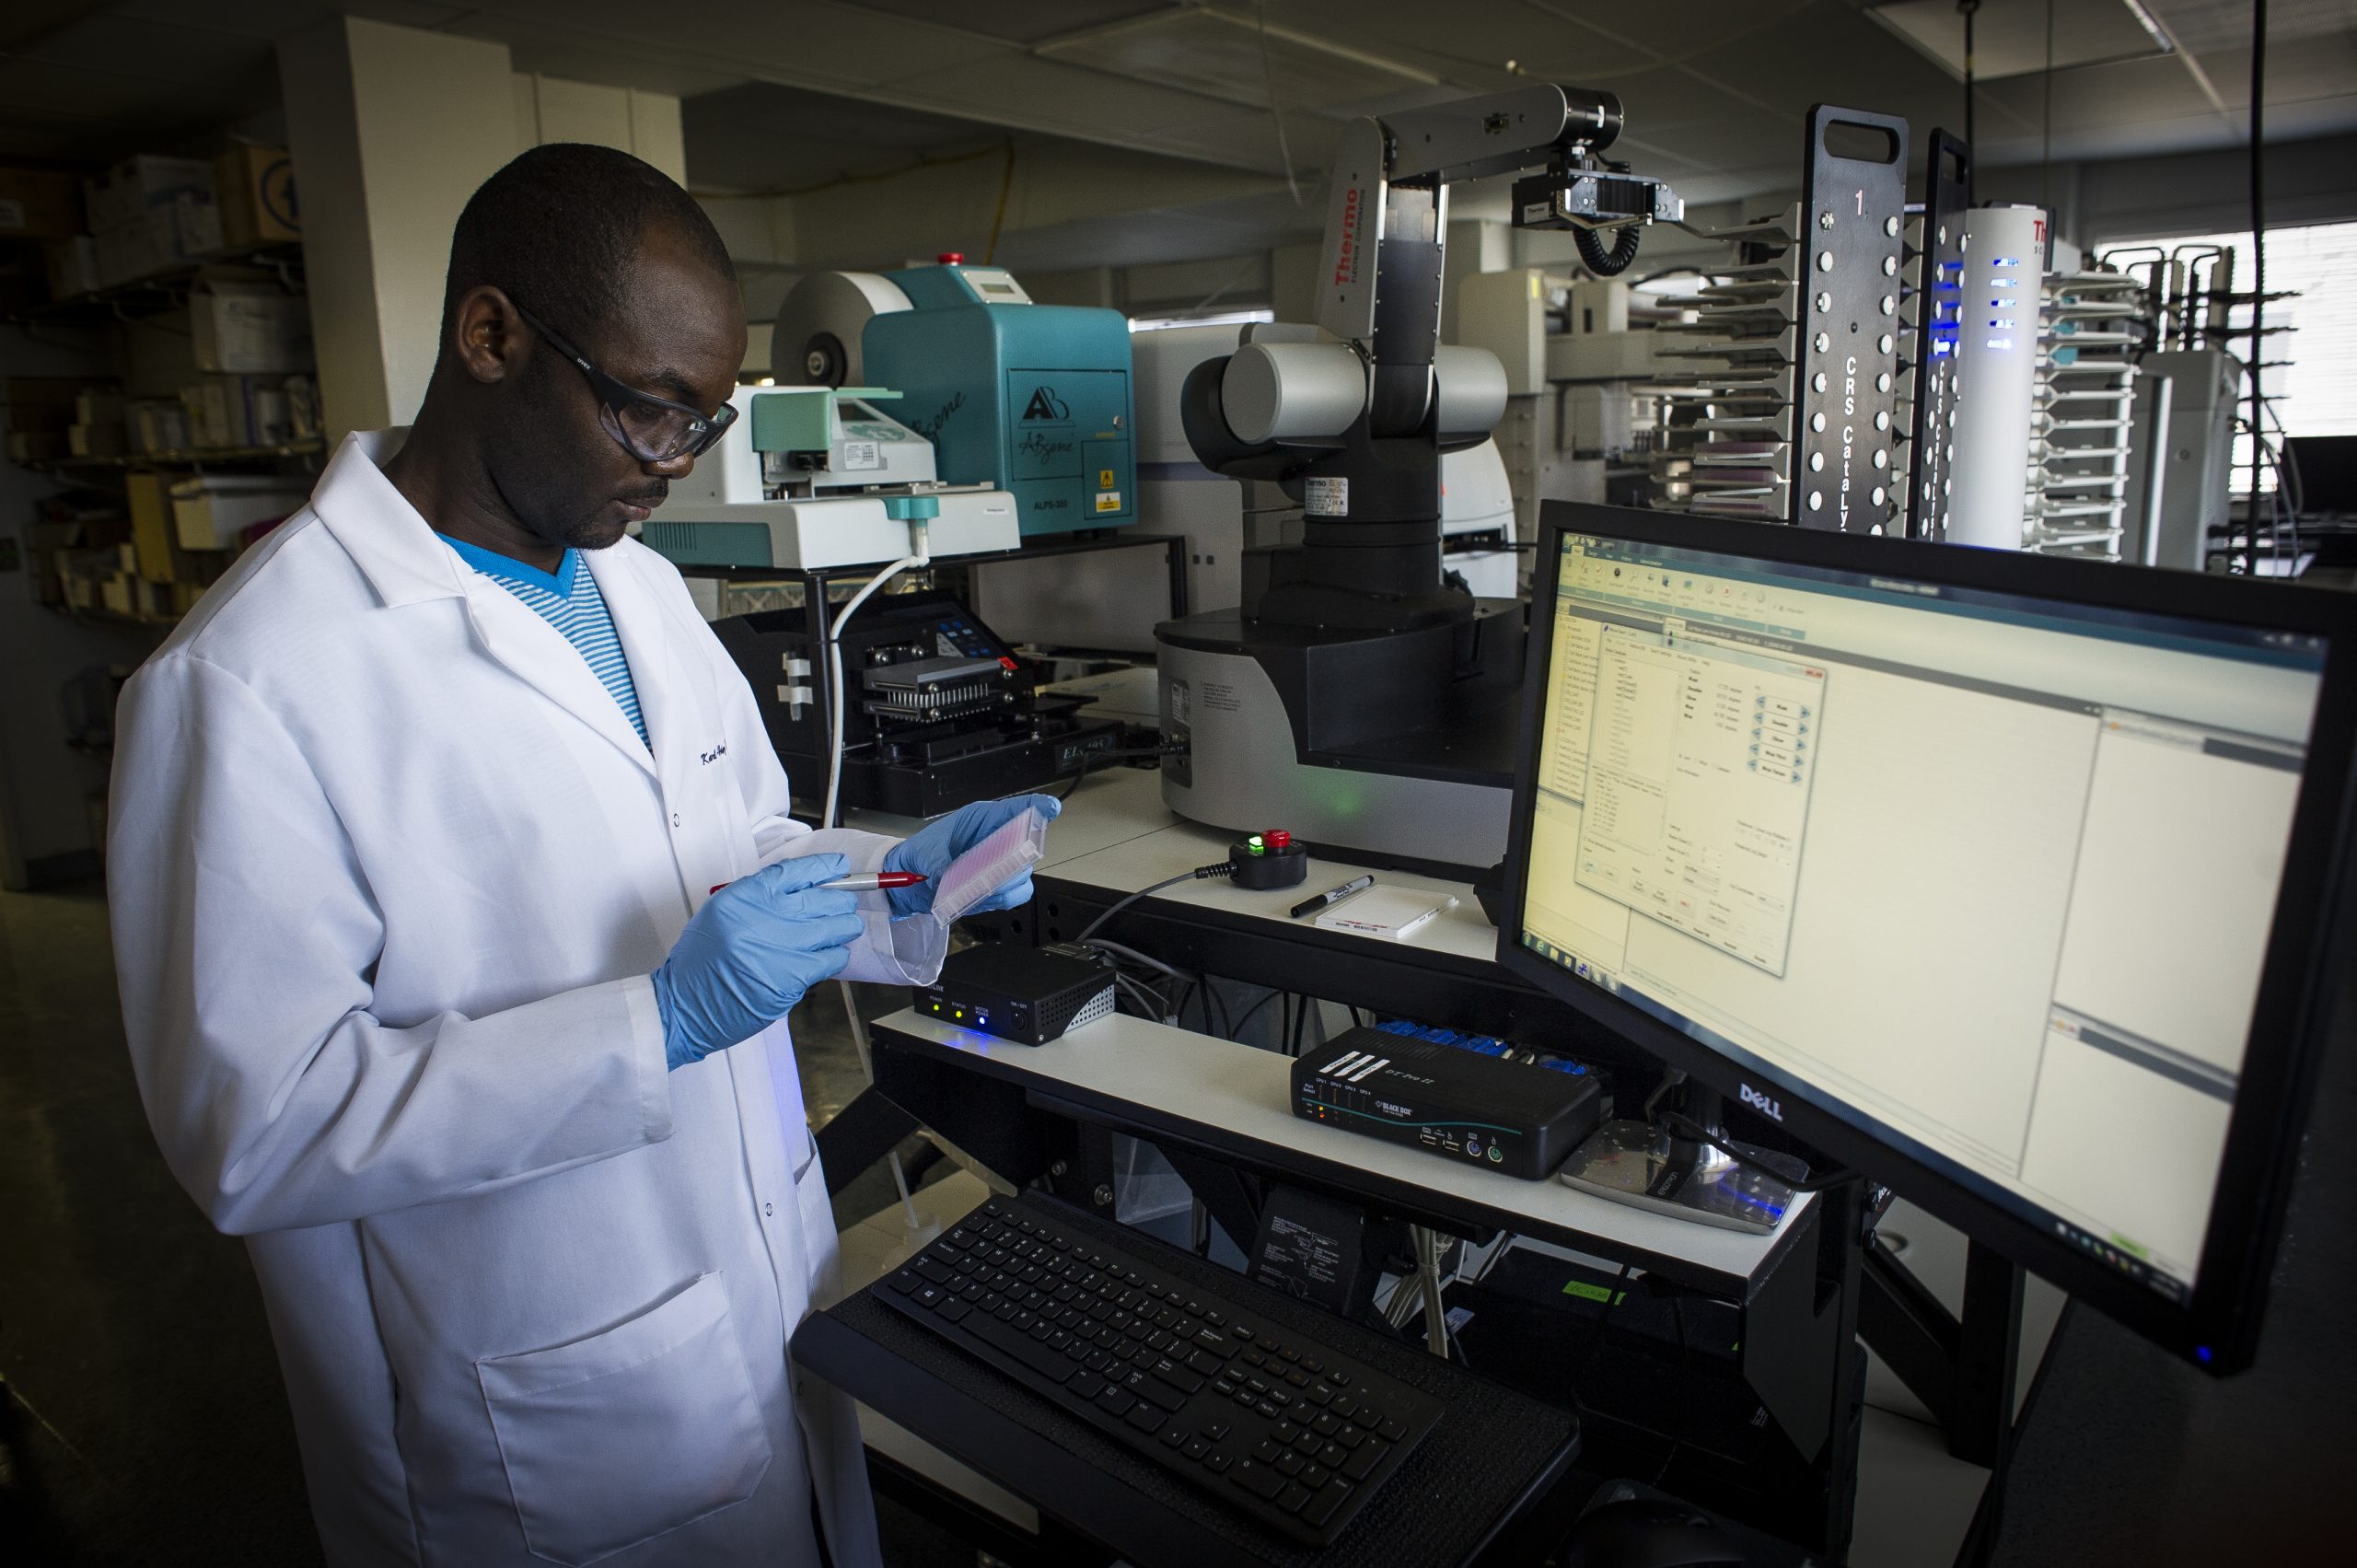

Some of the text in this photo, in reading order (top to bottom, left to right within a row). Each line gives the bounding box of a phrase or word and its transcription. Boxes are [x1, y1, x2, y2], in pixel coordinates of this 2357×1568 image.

[1855, 189, 1864, 215] 1
[1334, 188, 1358, 286] Thermo
[1840, 356, 1856, 532] CRS CataLy
[1382, 1101, 1399, 1112] BLACK
